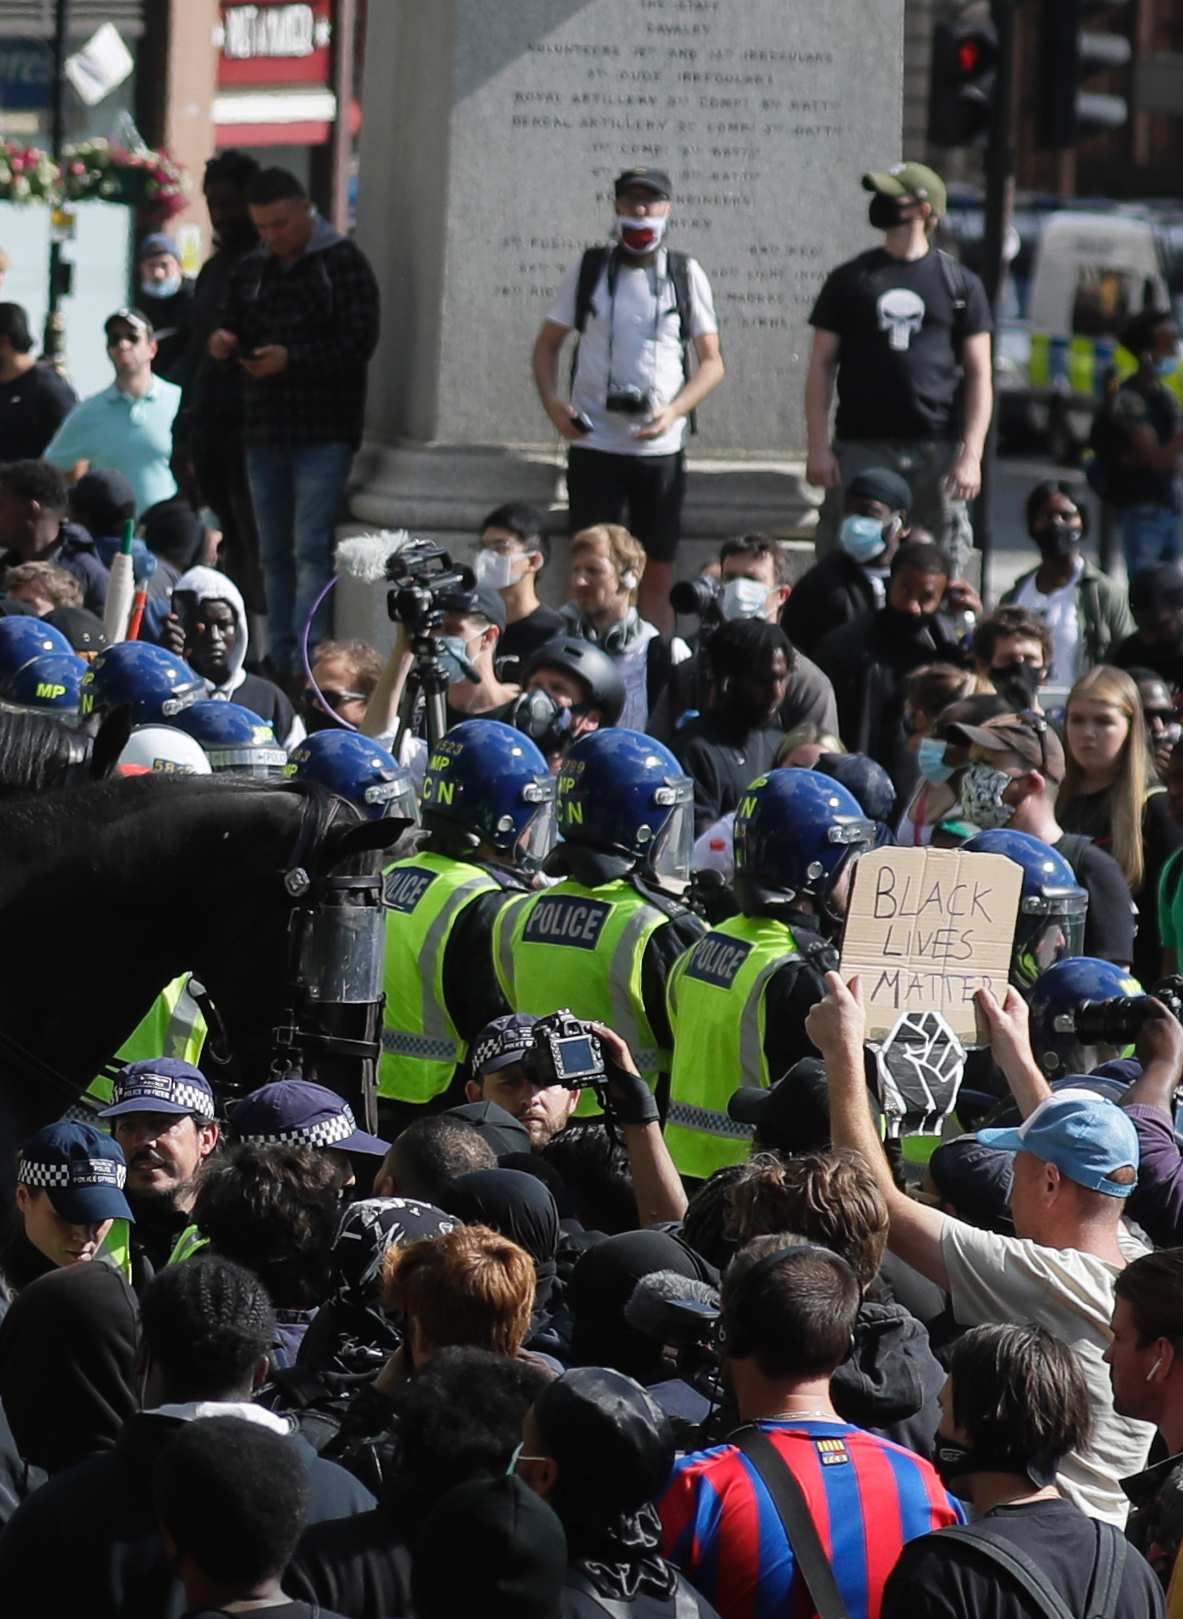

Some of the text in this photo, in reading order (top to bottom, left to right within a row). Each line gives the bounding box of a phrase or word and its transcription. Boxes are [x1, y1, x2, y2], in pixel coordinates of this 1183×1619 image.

[36, 683, 65, 699] MP
[873, 865, 993, 924] BLACK
[526, 900, 604, 941] POLICE
[693, 936, 746, 982] POLICE
[882, 925, 975, 961] LIVES
[869, 969, 1000, 1009] MATTER
